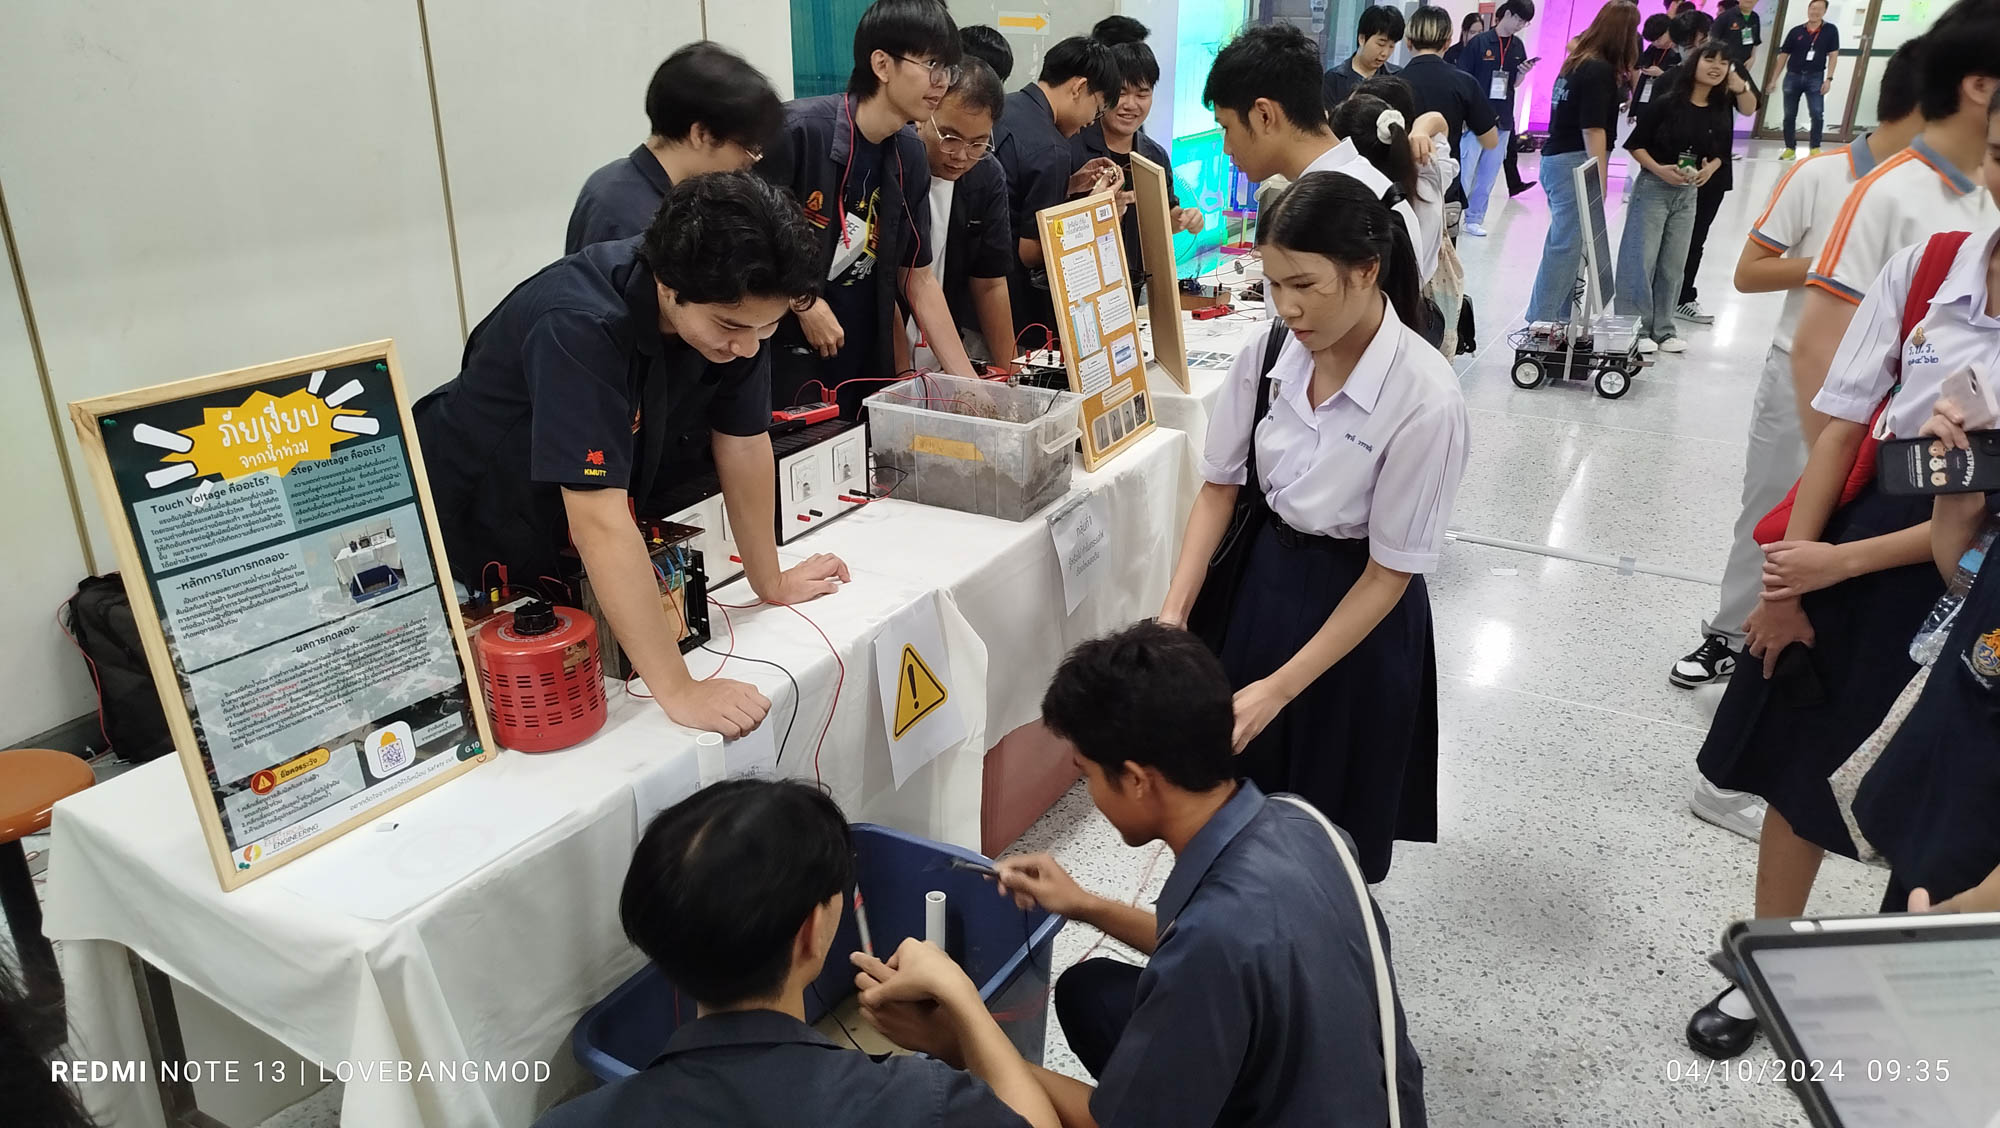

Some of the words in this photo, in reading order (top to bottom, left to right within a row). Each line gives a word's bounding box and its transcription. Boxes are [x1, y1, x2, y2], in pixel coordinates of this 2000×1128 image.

[217, 399, 320, 448] ภัยเงียบ
[239, 438, 309, 468] จากน้ำท่วม
[290, 462, 313, 477] Step
[313, 453, 350, 471] Voltage
[349, 442, 387, 460] คืออะไร?
[584, 468, 607, 477] KMUTT
[149, 497, 184, 515] Touch
[184, 486, 227, 507] Voltage
[227, 473, 271, 494] คืออะไร?
[464, 741, 480, 753] G.10
[272, 821, 319, 850] ENGINEERING
